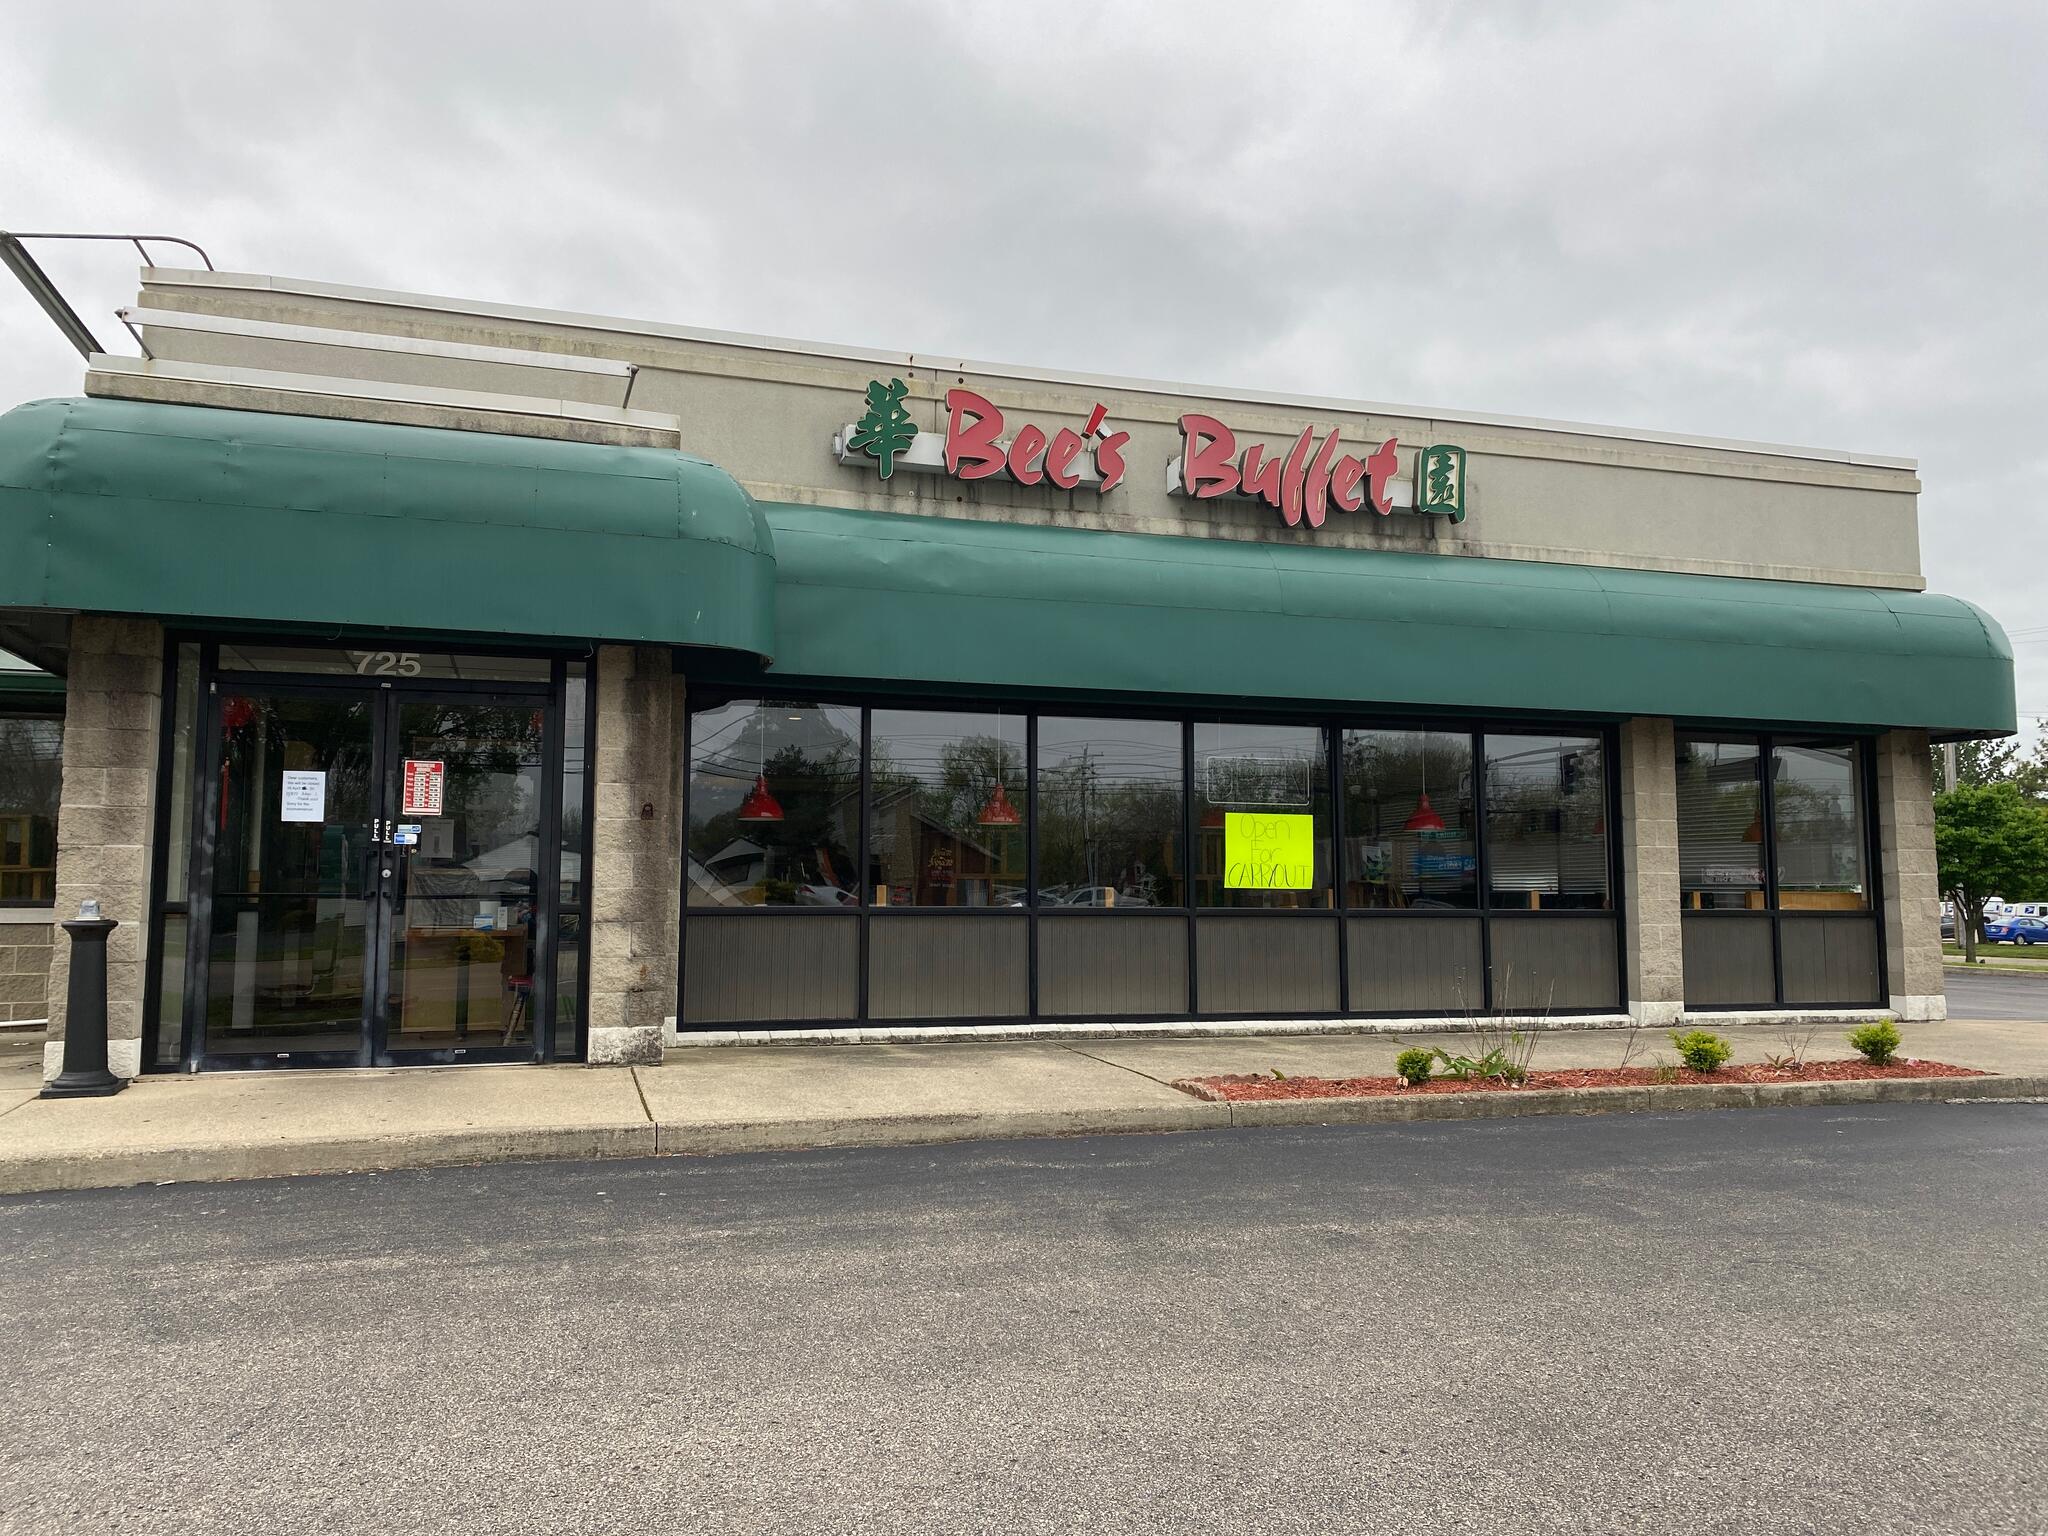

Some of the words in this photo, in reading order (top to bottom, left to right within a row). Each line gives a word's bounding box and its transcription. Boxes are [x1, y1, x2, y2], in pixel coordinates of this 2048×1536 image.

[943, 388, 1131, 492] Bee's
[1178, 413, 1399, 528] Buffet
[353, 650, 421, 676] 725
[1240, 813, 1291, 848] Open
